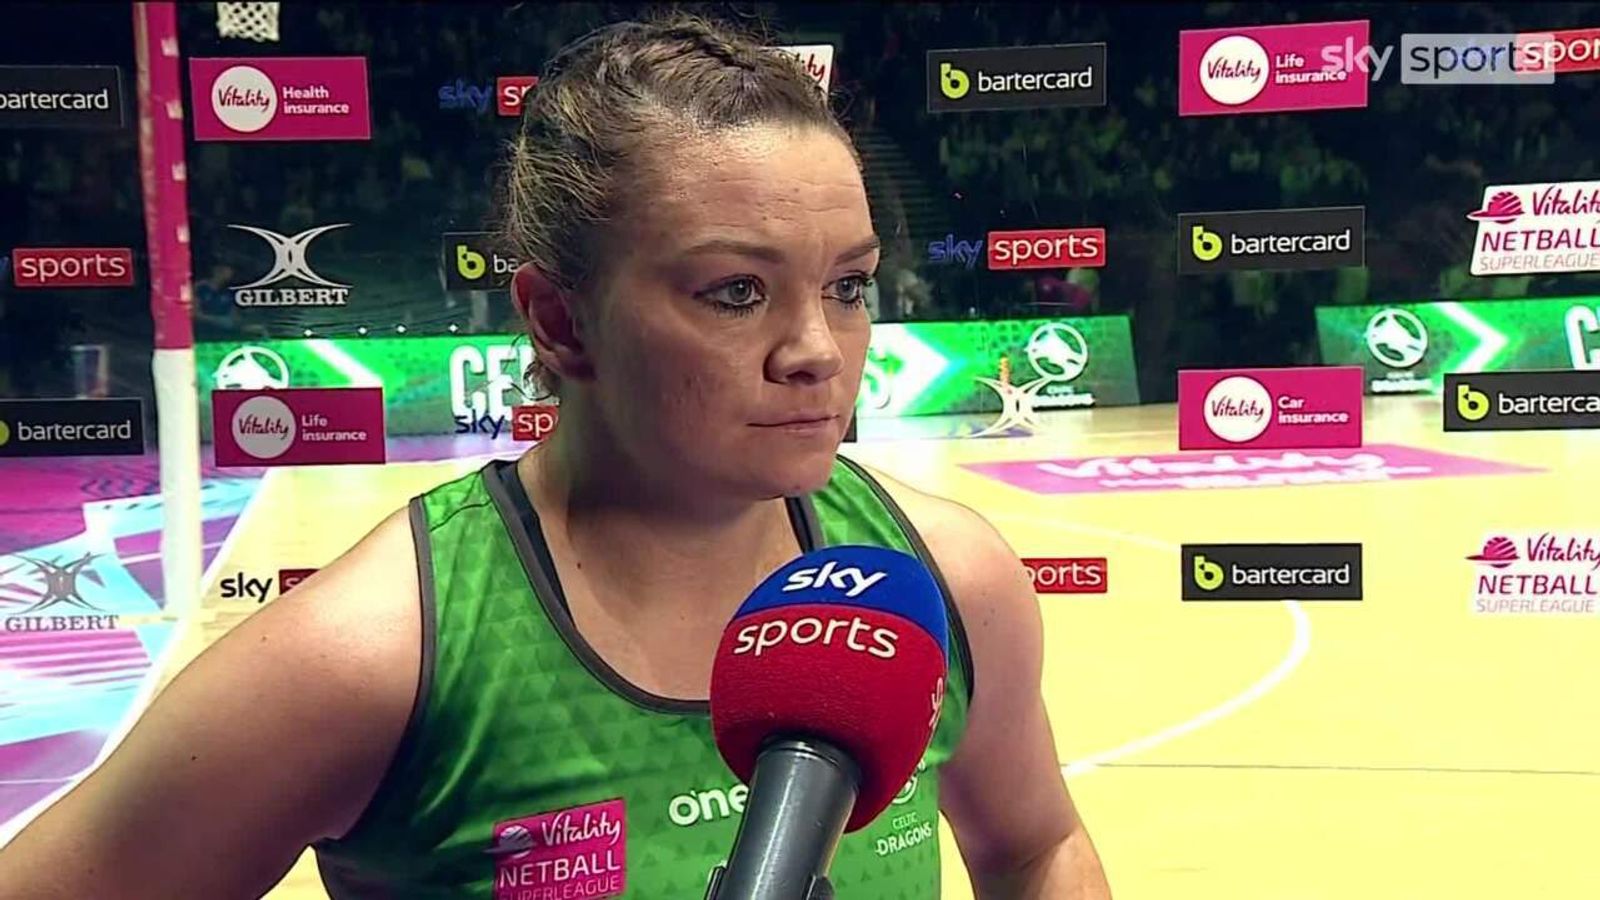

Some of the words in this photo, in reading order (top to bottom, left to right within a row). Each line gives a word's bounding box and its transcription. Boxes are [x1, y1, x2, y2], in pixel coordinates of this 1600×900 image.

[1208, 57, 1261, 83] Vitality
[1276, 54, 1304, 68] Life
[978, 66, 1093, 93] bartercard
[1275, 70, 1347, 84] insurance
[218, 86, 270, 112] Vitality
[283, 86, 329, 99] Health
[284, 101, 349, 115] insurance
[1532, 186, 1600, 224] Vitalit
[928, 234, 983, 268] sky
[994, 234, 1099, 265] sports
[1231, 229, 1350, 254] bartercard
[1481, 228, 1600, 252] NETBALL
[21, 253, 125, 282] sports
[1480, 252, 1600, 271] SUPERLEAGUE
[235, 289, 349, 306] GILBERT
[1211, 395, 1265, 422] Vitality
[1278, 396, 1304, 408] Car
[239, 414, 290, 440] Vitality
[301, 414, 328, 427] Life
[454, 409, 504, 440] sky
[1278, 410, 1349, 424] insurance
[18, 420, 131, 441] bartercard
[302, 429, 367, 441] insurance
[782, 561, 888, 597] sky
[1232, 564, 1350, 585] bartercard
[1478, 574, 1598, 595] NETBALL
[220, 572, 273, 603] sky
[1476, 598, 1595, 613] SUPERLEAGUE
[5, 615, 119, 632] GILBERT
[733, 616, 899, 659] sports
[541, 811, 621, 846] Vitality
[875, 822, 932, 856] DRAGONS
[499, 850, 621, 888] NETBALL
